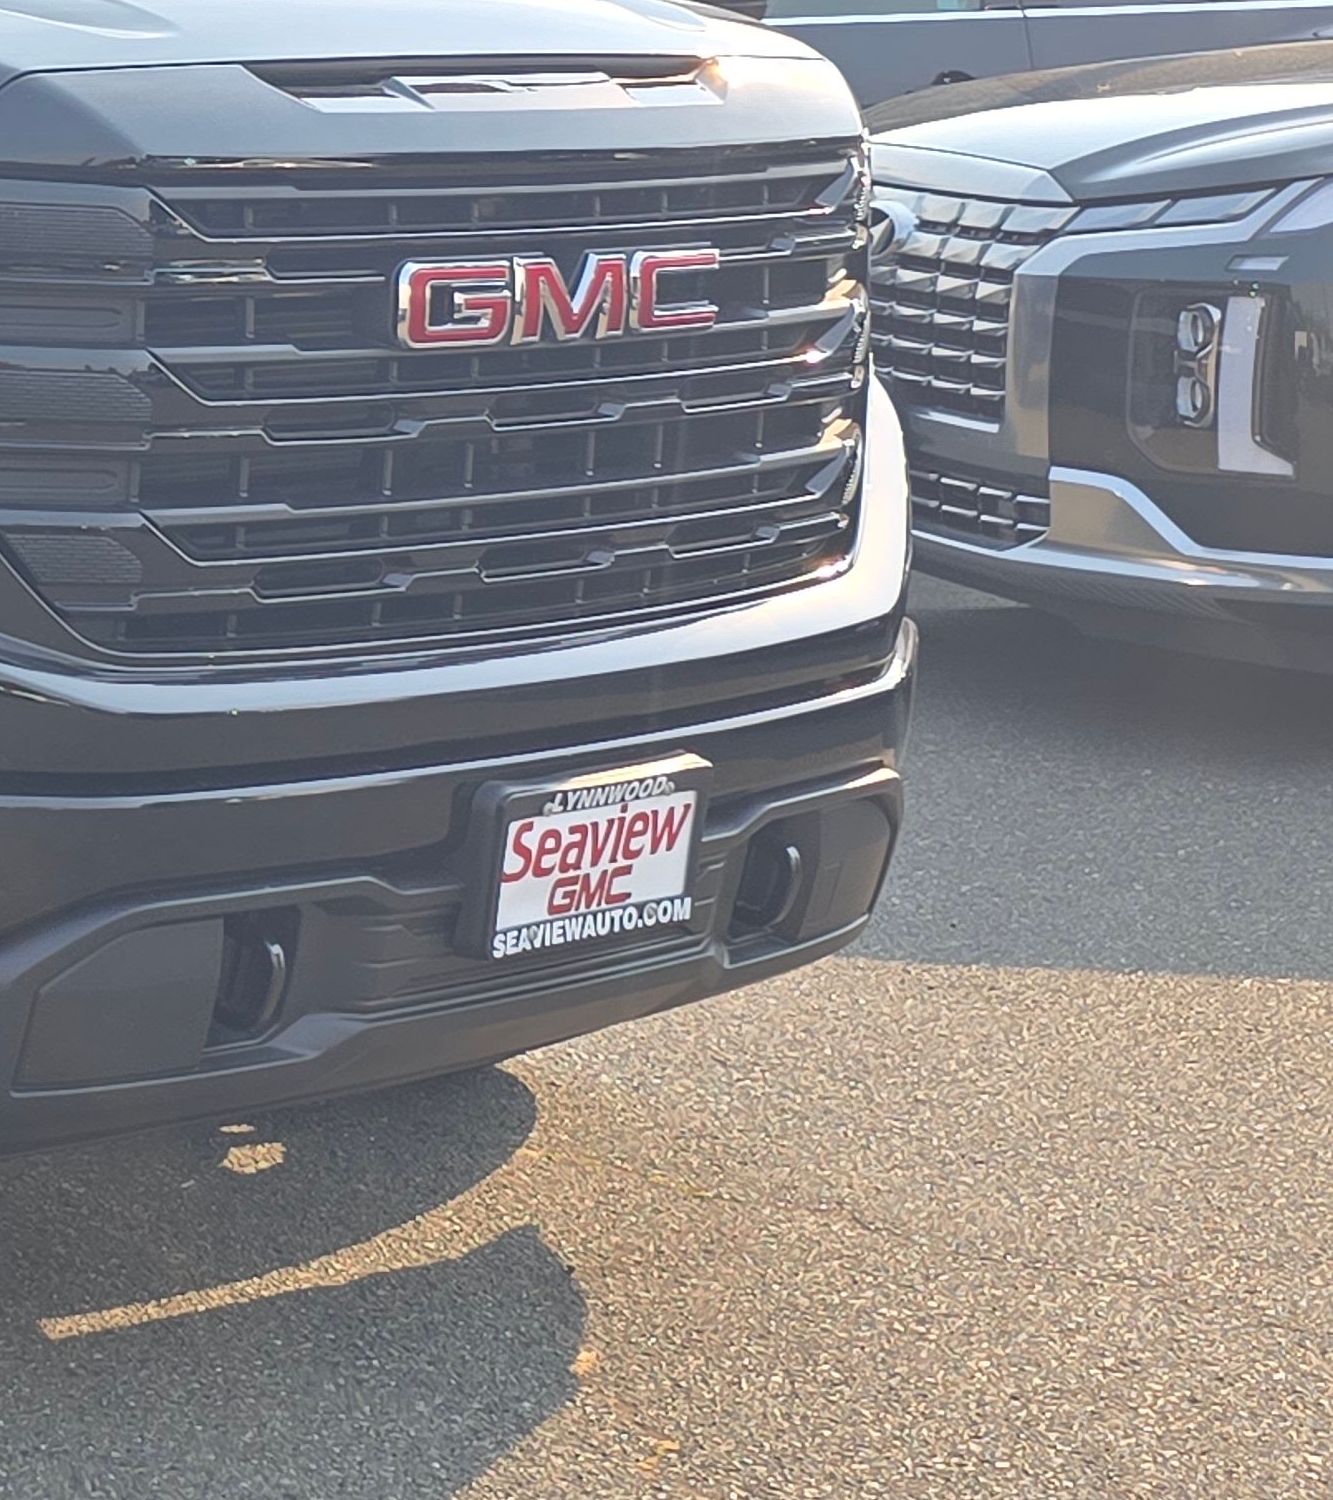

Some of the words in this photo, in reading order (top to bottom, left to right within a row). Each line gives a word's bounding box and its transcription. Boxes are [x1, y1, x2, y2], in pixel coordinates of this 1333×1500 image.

[397, 248, 720, 349] GMC
[551, 776, 668, 813] LYNNWOOD
[500, 803, 692, 883] Seaview
[547, 864, 633, 916] GMC
[492, 897, 692, 959] SEAVIEWAUTO.COM
